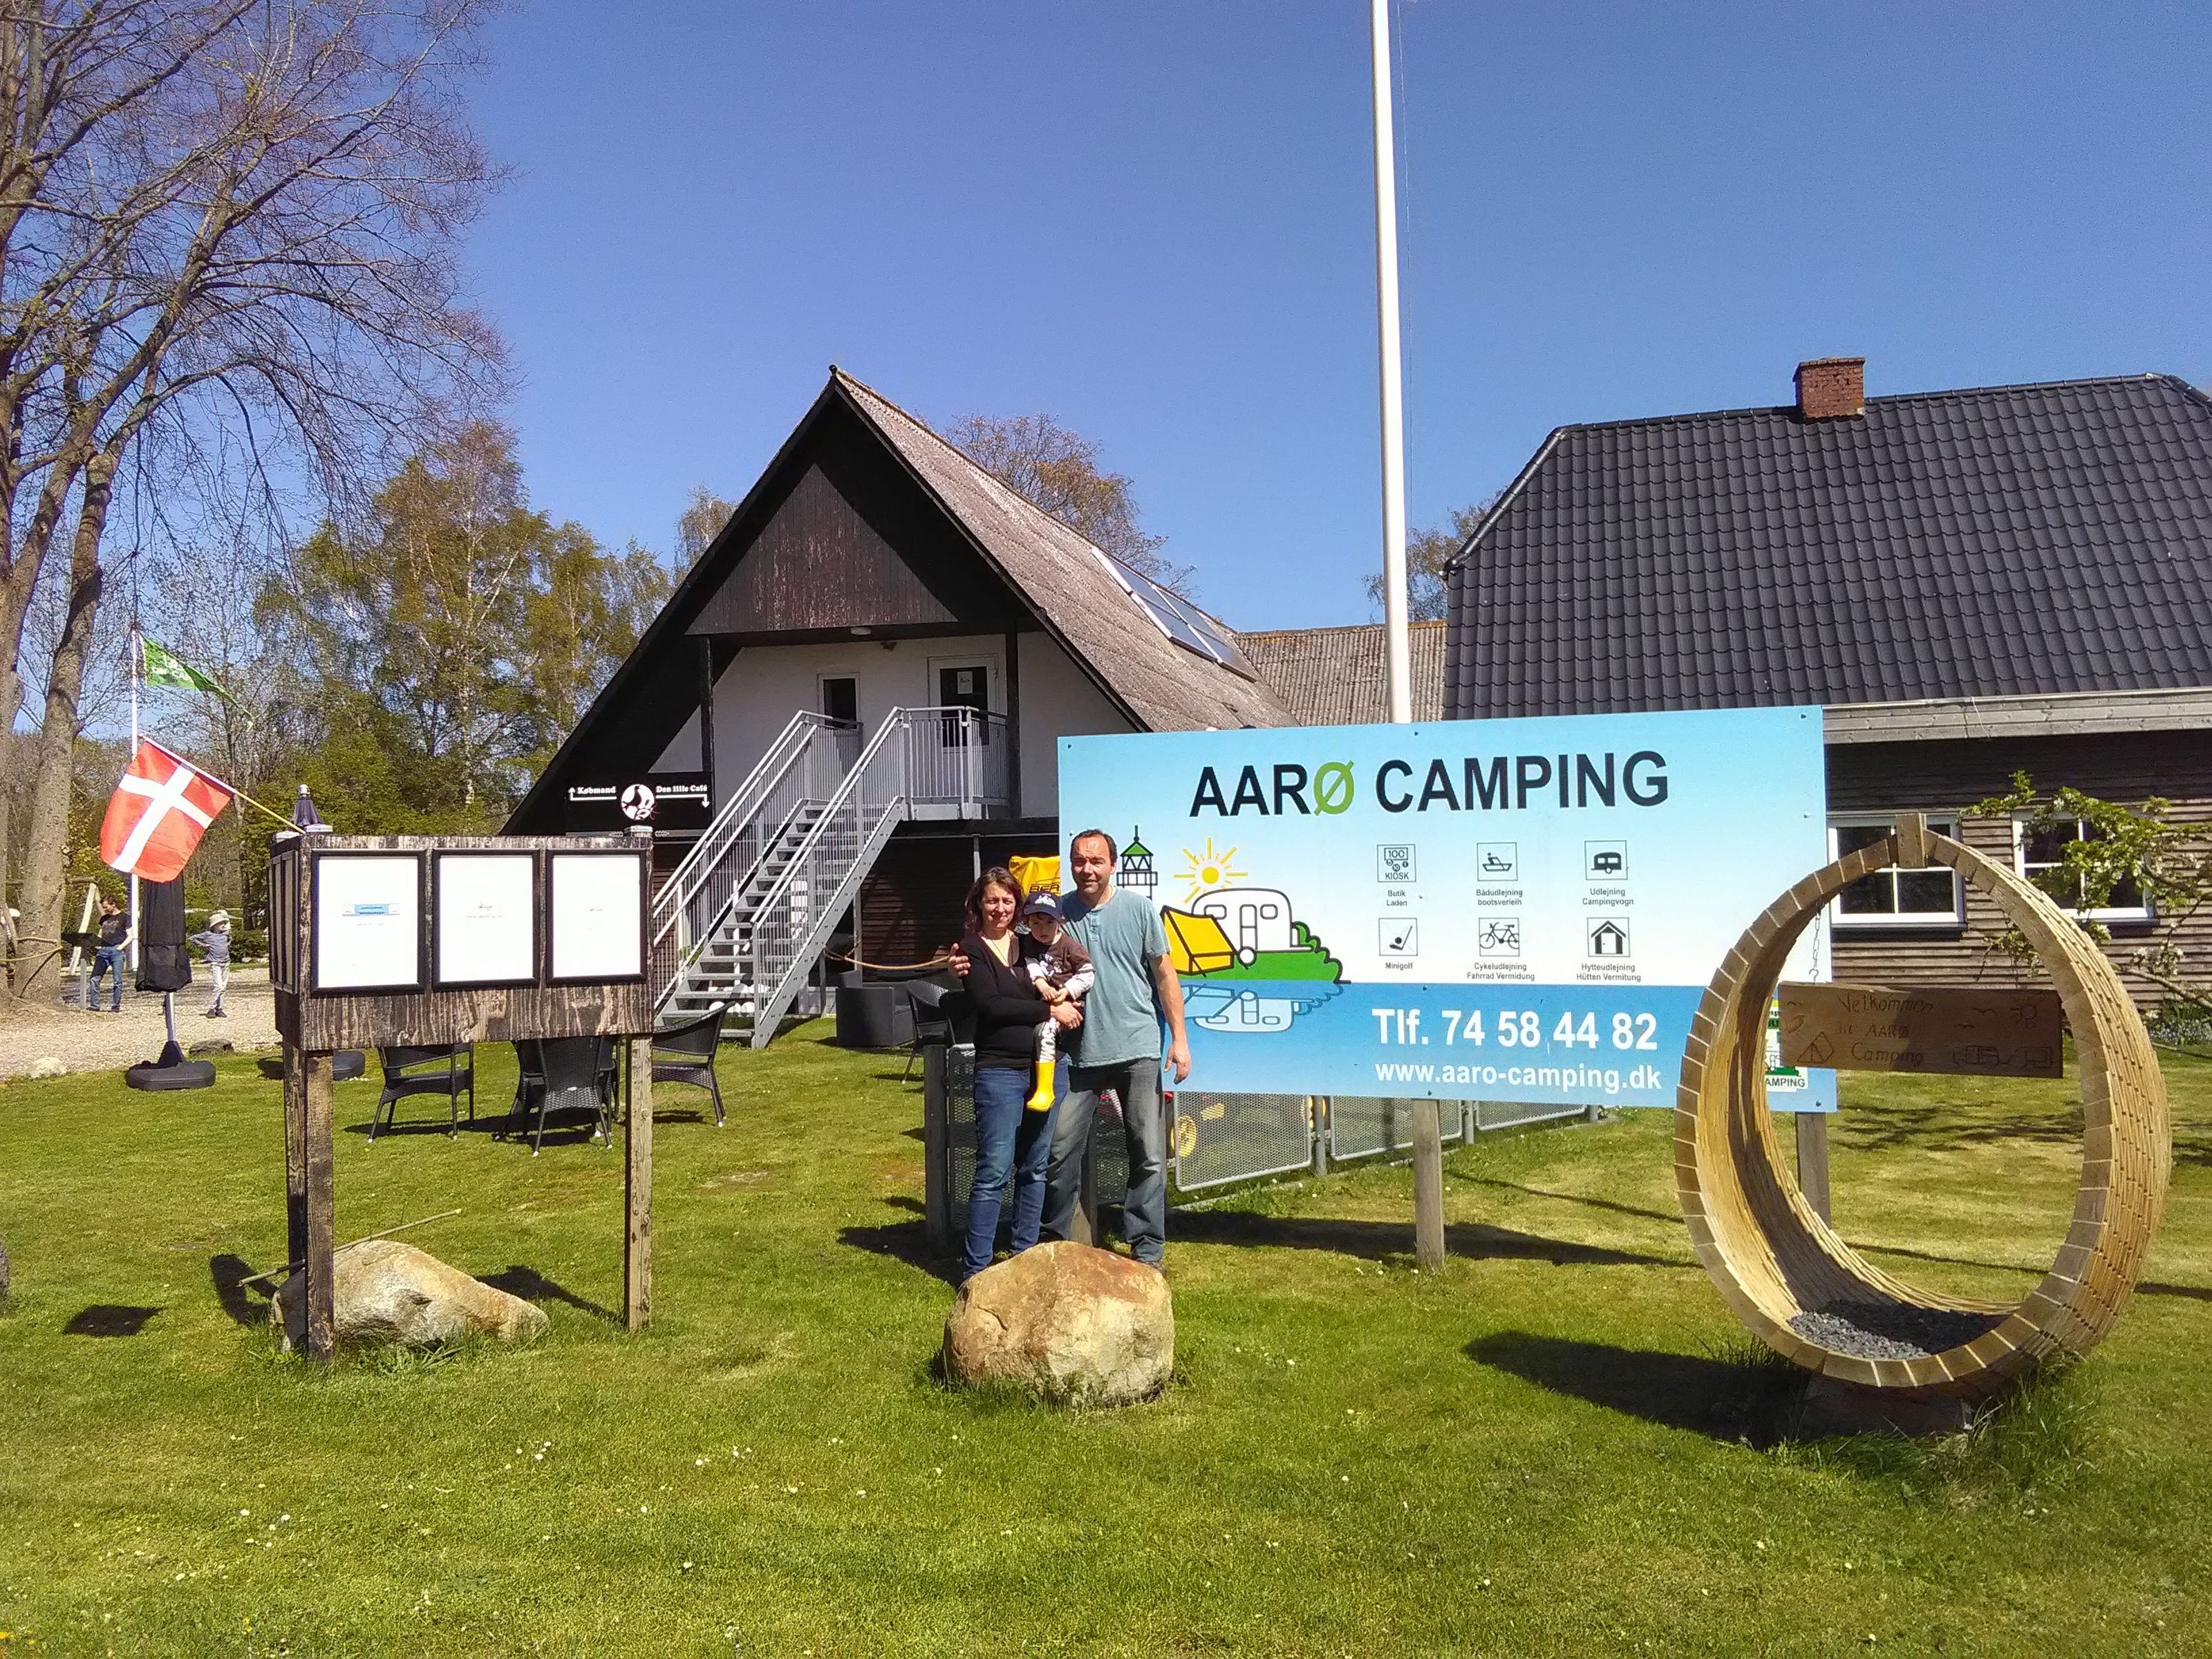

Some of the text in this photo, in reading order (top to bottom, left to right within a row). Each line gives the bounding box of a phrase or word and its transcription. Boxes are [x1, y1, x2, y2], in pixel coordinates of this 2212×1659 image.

[690, 784, 708, 792] Café
[1190, 750, 1668, 818] AARØ CAMPING
[577, 786, 617, 795] Købmand
[1388, 850, 1405, 858] 100
[1385, 872, 1409, 880] KIOSK
[1476, 888, 1523, 898] Bådudlejning
[1589, 888, 1626, 897] Udlejning
[1477, 898, 1522, 906] bootsverleih
[1582, 897, 1634, 907] Campingvogn
[1385, 962, 1413, 971] Minigolf
[1474, 962, 1527, 972] Cykeludlejning
[1581, 963, 1635, 973] Hytteudlejning
[1467, 972, 1494, 980] Fahrrad
[1576, 973, 1642, 983] Hütten Vermitung
[1837, 992, 1934, 1013] Velkommen
[1371, 1009, 1658, 1051] Tlf. 74 58 44 82
[1851, 1042, 1924, 1067] Camping
[1374, 1062, 1662, 1094] www.aaro-camping.dk
[1765, 1078, 1806, 1087] AMPING
